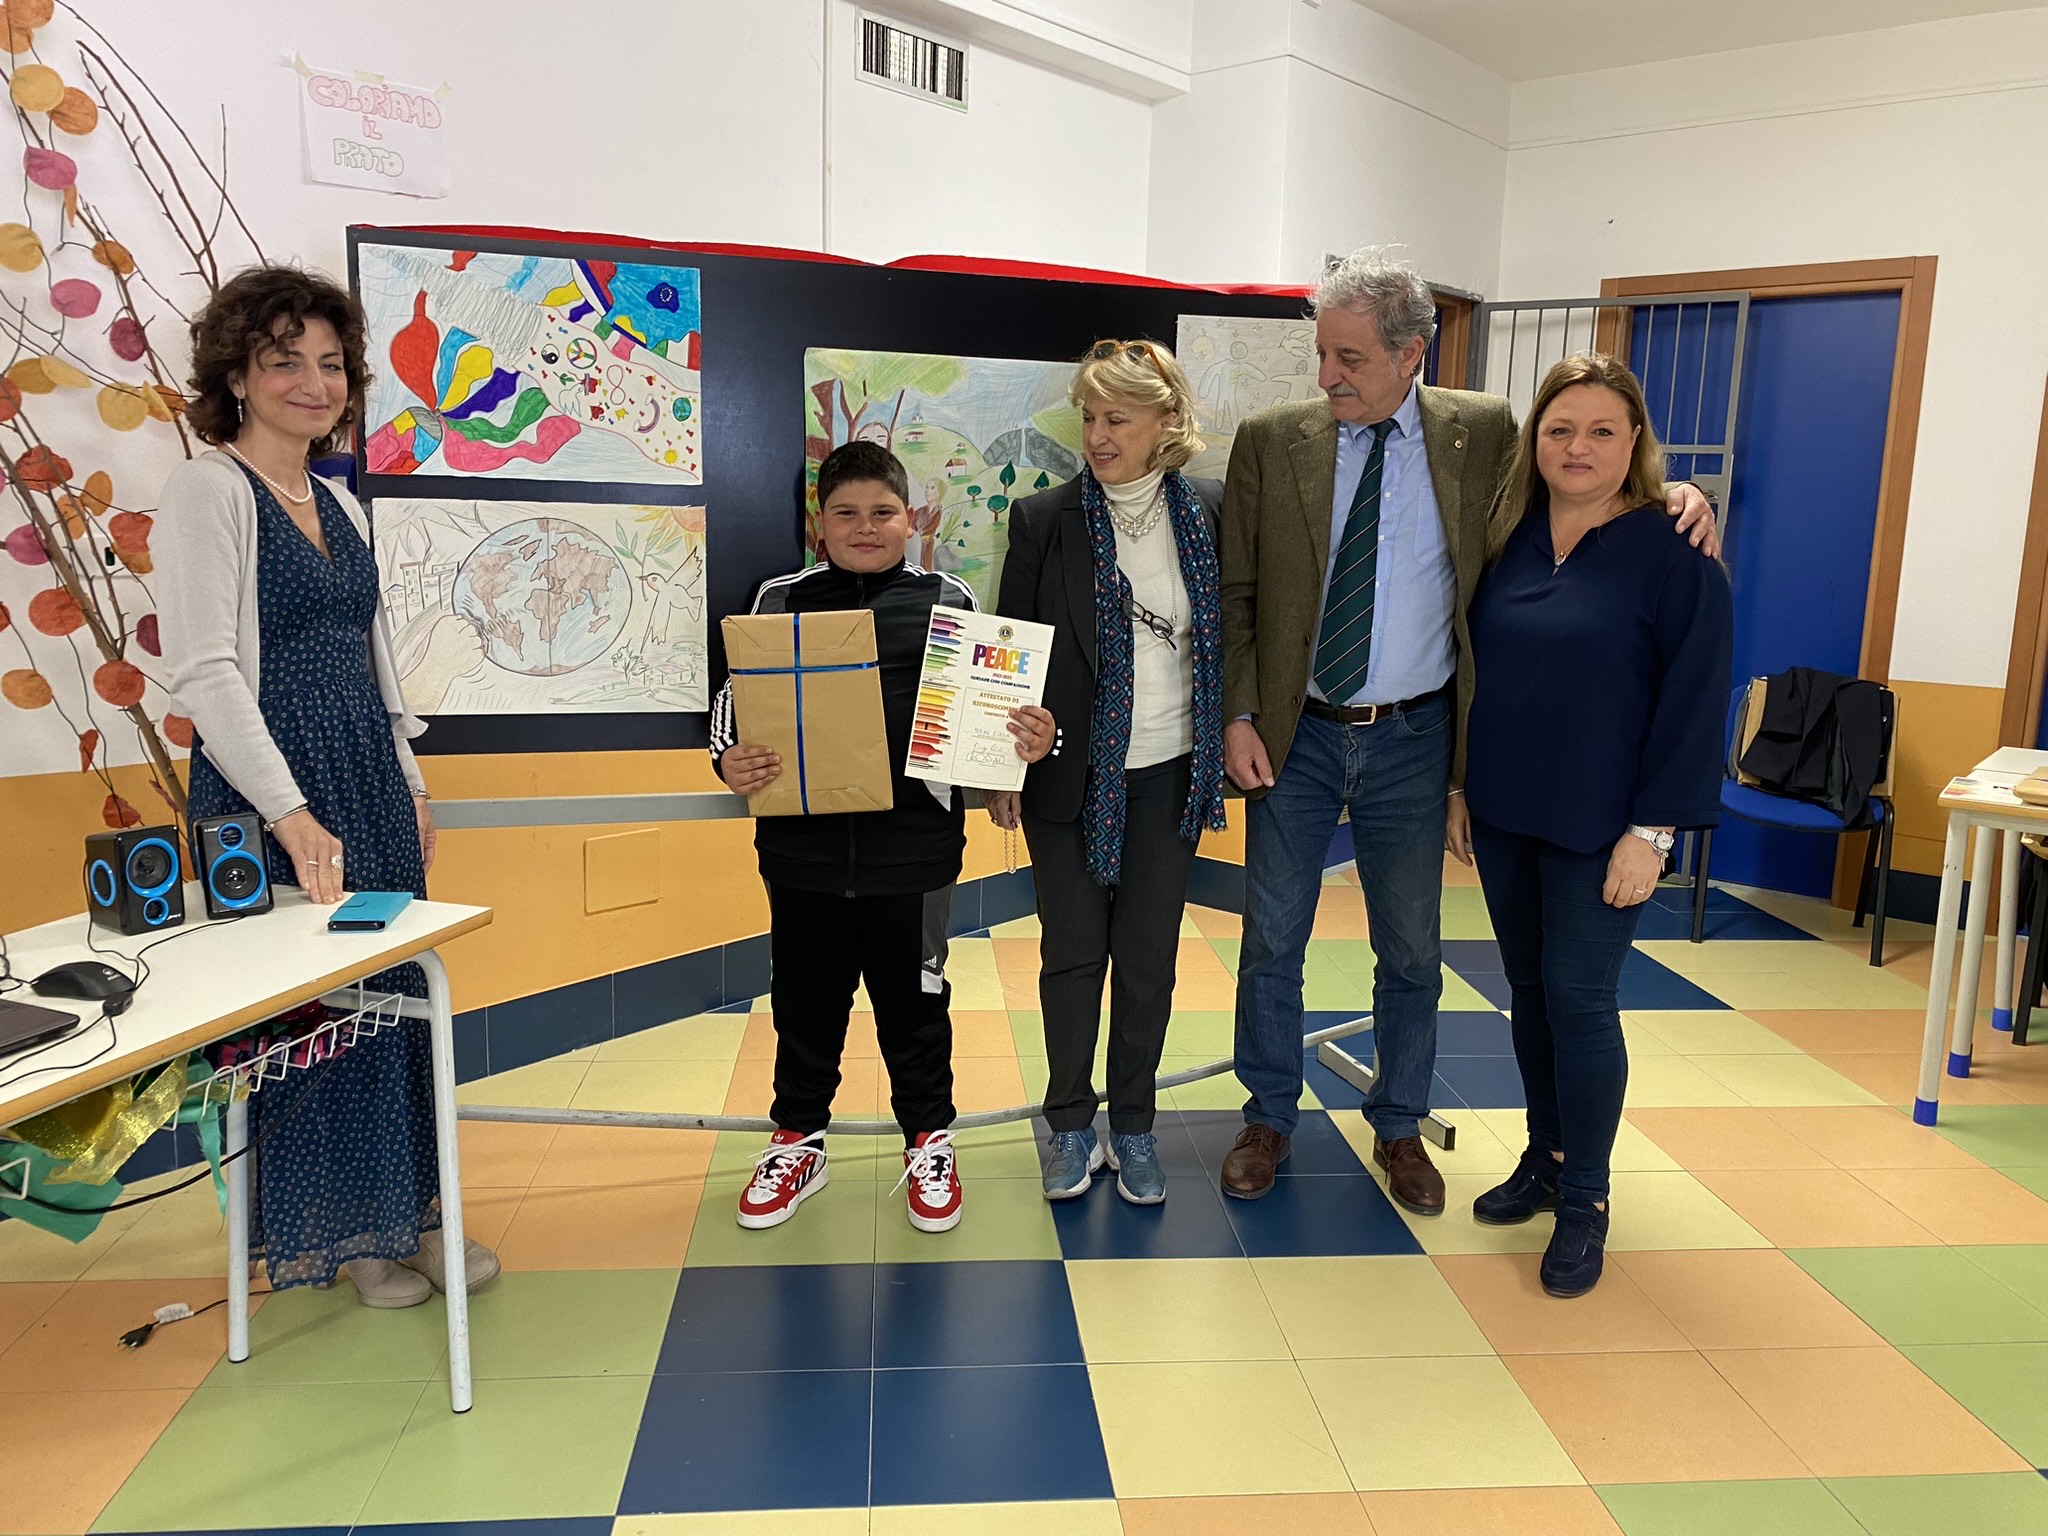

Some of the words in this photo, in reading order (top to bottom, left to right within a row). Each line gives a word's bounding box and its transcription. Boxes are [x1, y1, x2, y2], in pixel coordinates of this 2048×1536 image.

[333, 138, 404, 177] PRATO
[972, 643, 1030, 675] PEACE
[970, 675, 990, 683] GUIDARE
[1001, 680, 1031, 689] COMPASSIONE
[979, 692, 1011, 702] ATTESTATO
[972, 700, 1012, 711] RICONOSCIM
